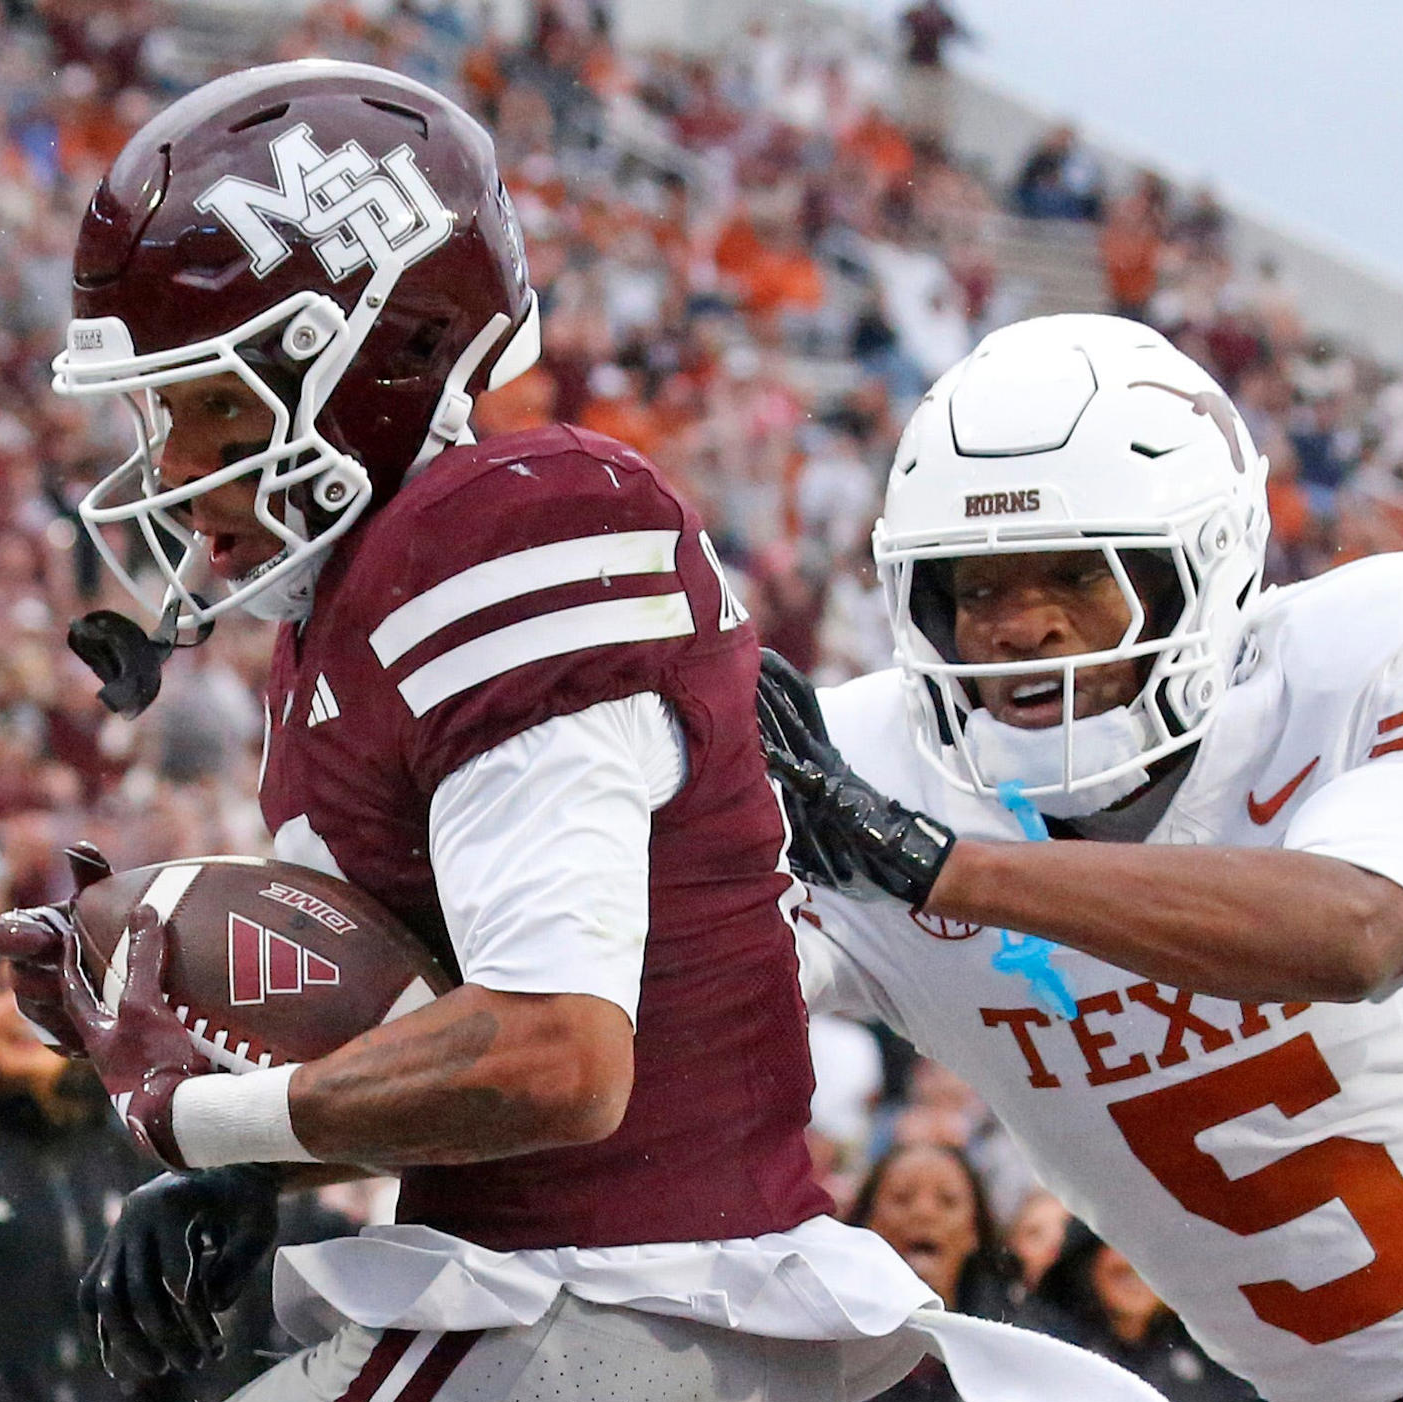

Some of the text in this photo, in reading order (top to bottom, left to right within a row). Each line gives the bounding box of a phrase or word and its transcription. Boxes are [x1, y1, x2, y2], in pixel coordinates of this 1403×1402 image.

[193, 122, 453, 283] MSU
[964, 489, 1040, 517] HORNS
[258, 882, 358, 935] DIME
[980, 981, 1311, 1088] TEX
